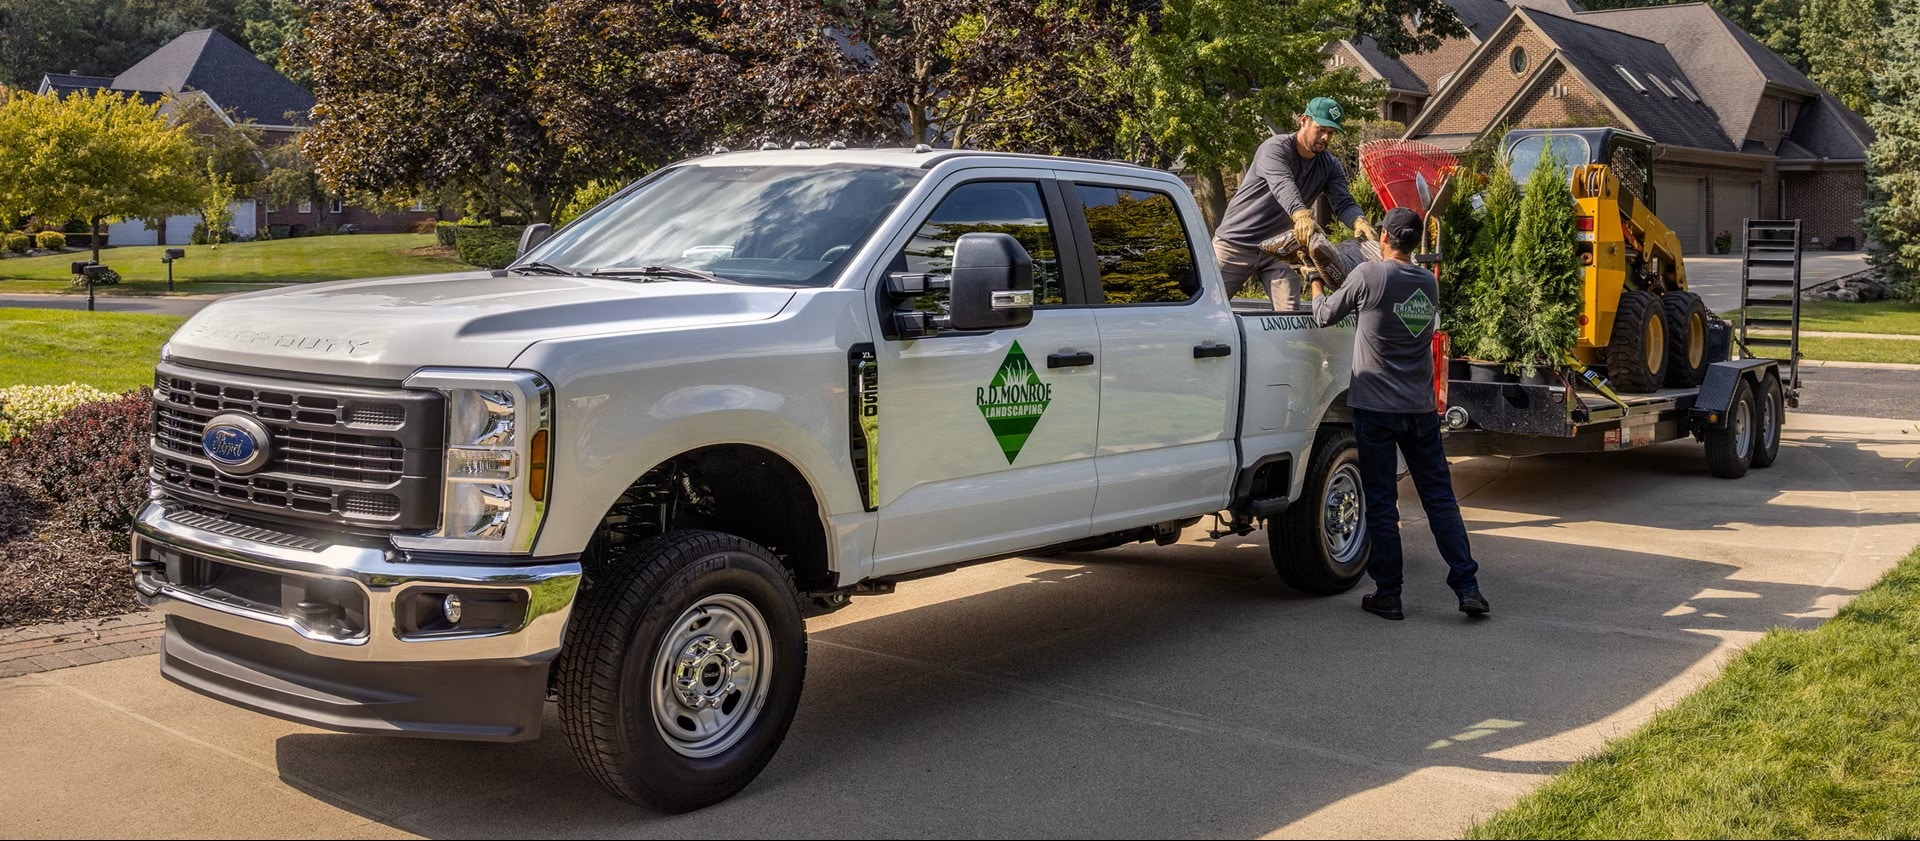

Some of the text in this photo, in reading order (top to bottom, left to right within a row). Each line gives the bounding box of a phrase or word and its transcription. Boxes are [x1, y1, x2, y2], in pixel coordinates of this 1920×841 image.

[1260, 316, 1319, 331] LANDSCAPIN
[985, 404, 1043, 418] LANDSCAPING
[212, 429, 244, 457] Ford
